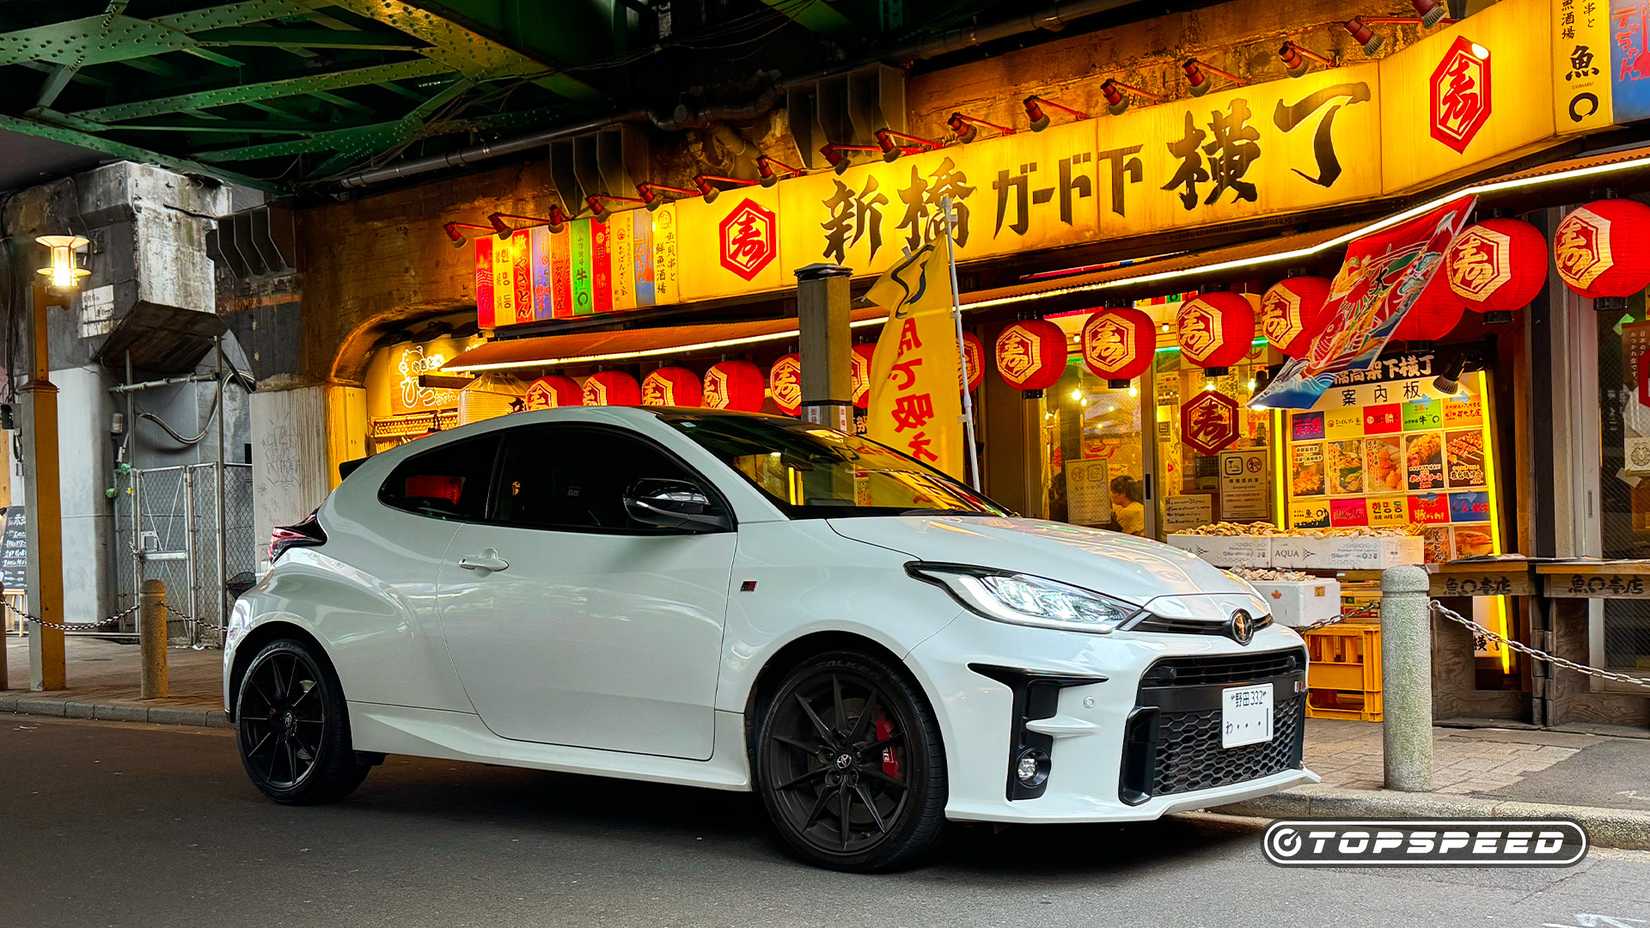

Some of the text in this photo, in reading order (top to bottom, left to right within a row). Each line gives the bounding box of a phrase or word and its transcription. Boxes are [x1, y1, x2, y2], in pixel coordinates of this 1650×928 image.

[1342, 380, 1421, 407] 案内板
[1275, 550, 1299, 559] AQUA
